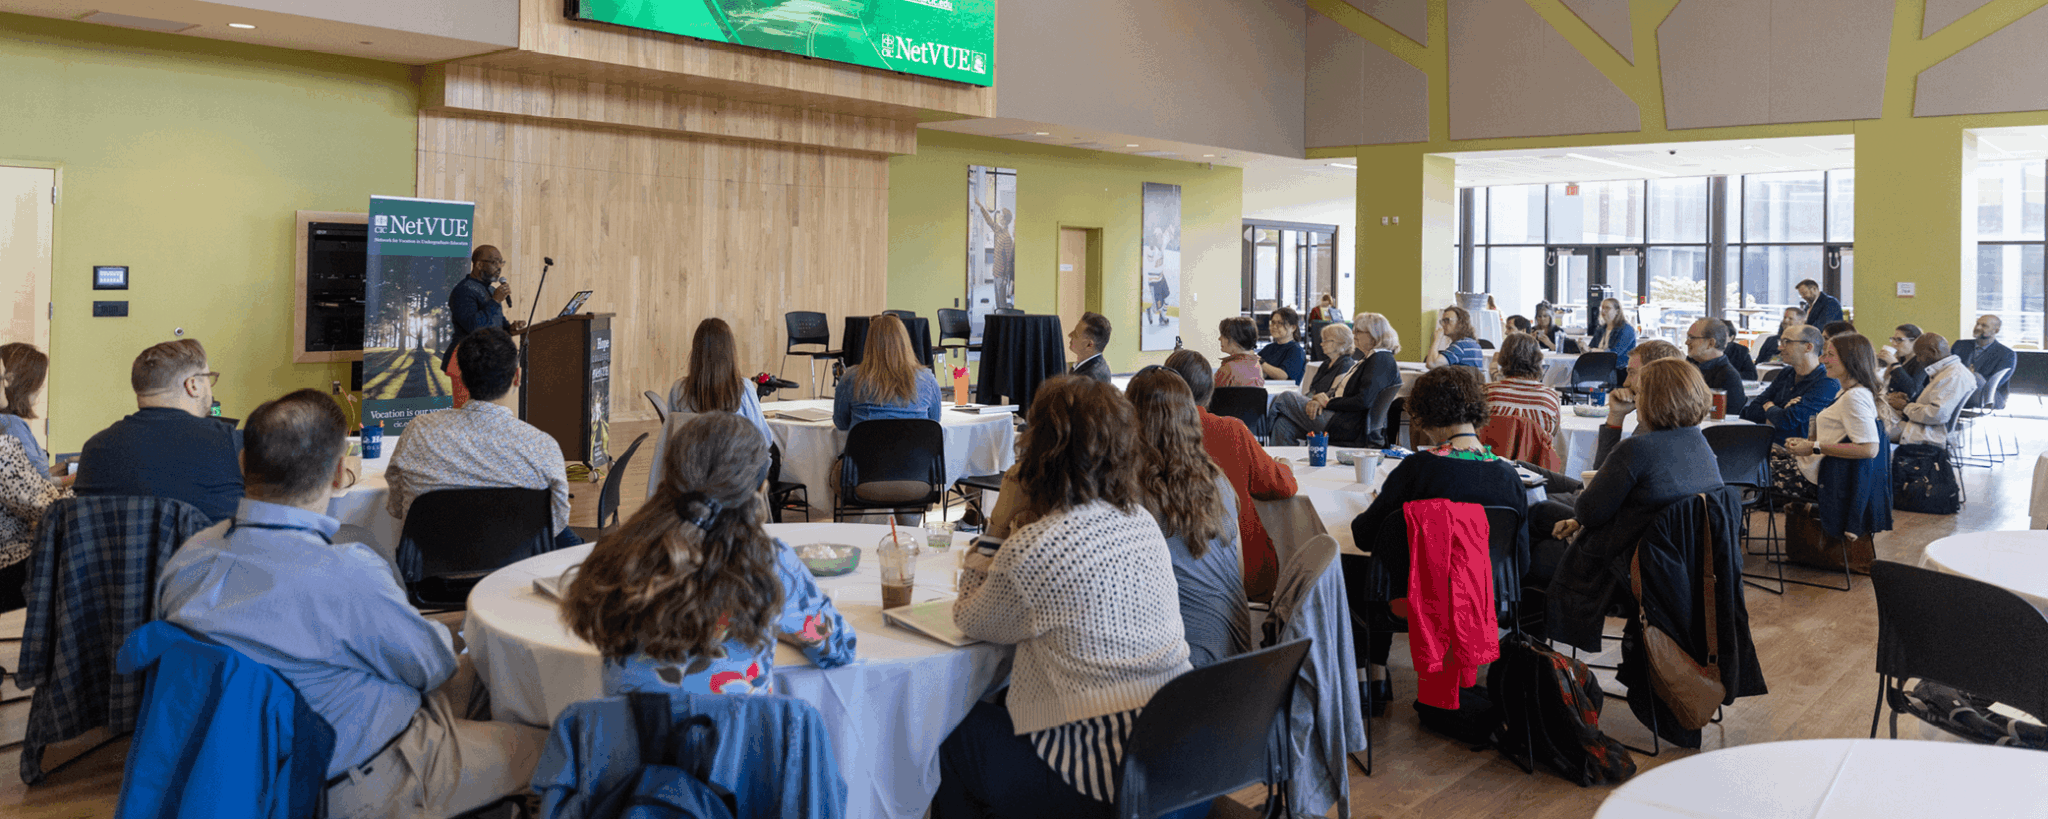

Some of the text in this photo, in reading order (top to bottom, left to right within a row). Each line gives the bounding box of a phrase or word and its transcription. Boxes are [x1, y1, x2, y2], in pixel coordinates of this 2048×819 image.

[895, 35, 971, 71] NetVUE
[389, 215, 469, 237] NetVUE
[597, 337, 610, 352] Hope
[370, 409, 405, 419] Vocation
[406, 408, 414, 417] is
